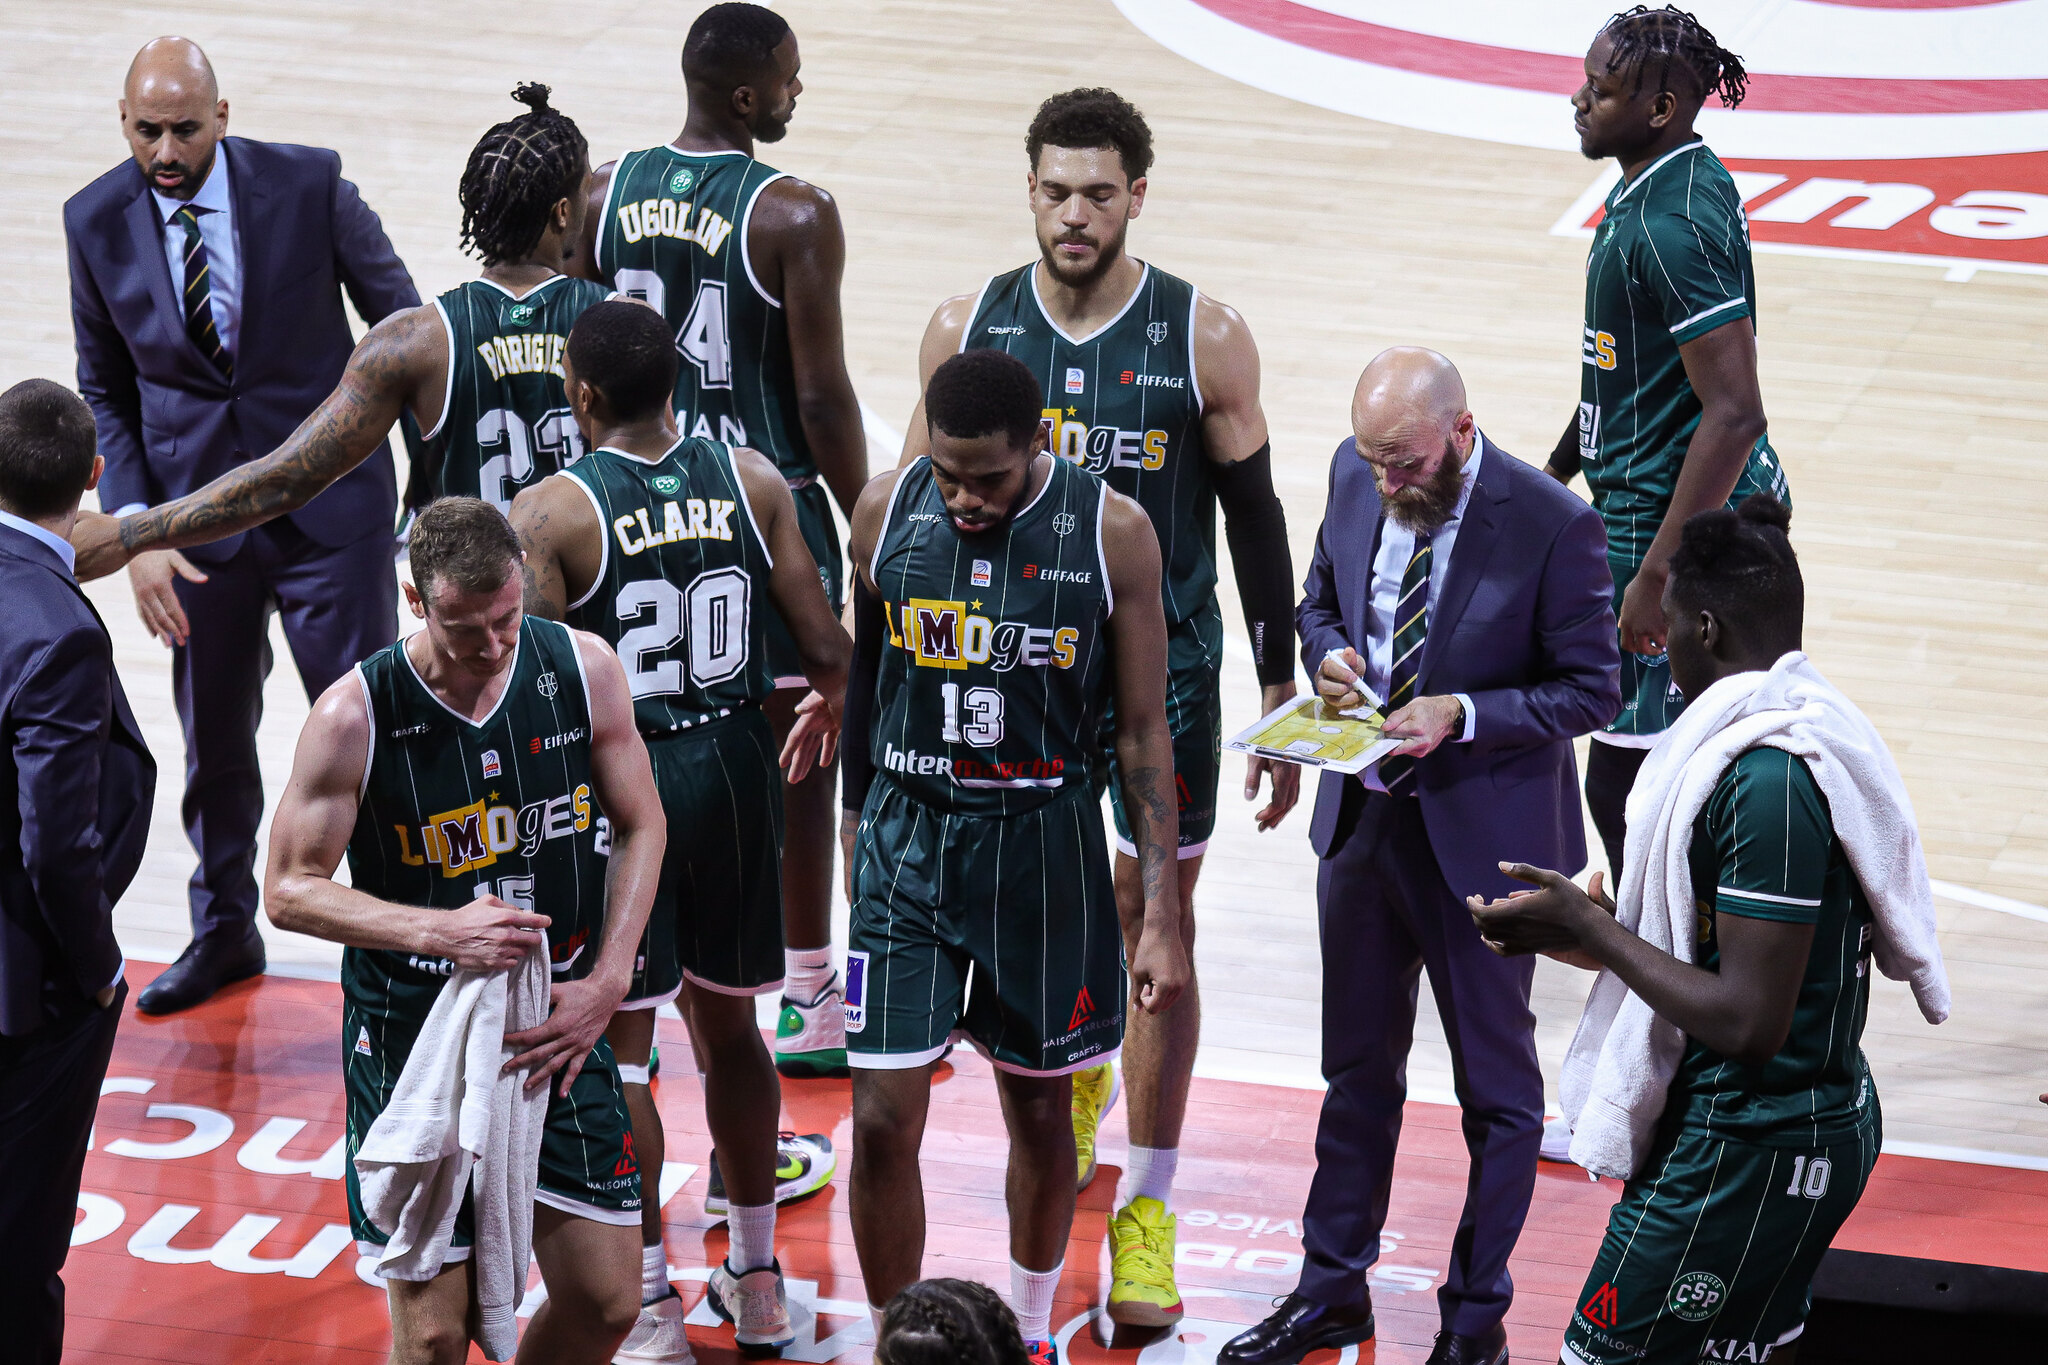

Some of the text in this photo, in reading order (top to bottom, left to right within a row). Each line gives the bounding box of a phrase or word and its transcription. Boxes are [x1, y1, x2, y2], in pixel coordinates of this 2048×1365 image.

[618, 199, 733, 257] UGOLIN
[988, 326, 1016, 335] CRAFT
[1136, 374, 1184, 389] EIFFAGE
[613, 498, 736, 556] CLARK
[1040, 568, 1092, 584] EIFFAGE
[616, 565, 751, 701] 20
[941, 683, 1005, 748] 13
[544, 727, 586, 750] EIFFAGE
[1042, 1012, 1123, 1050] MAISONS ARLOGIS
[1068, 1046, 1095, 1062] CRAFT
[586, 1177, 632, 1190] MAISONS
[1787, 1155, 1832, 1200] 10
[622, 1199, 641, 1208] CRAF
[1687, 1274, 1721, 1289] LIMOGES
[1676, 1282, 1719, 1308] CSP
[1569, 1340, 1595, 1362] CRAFT
[1593, 1331, 1647, 1359] ARLOGIS
